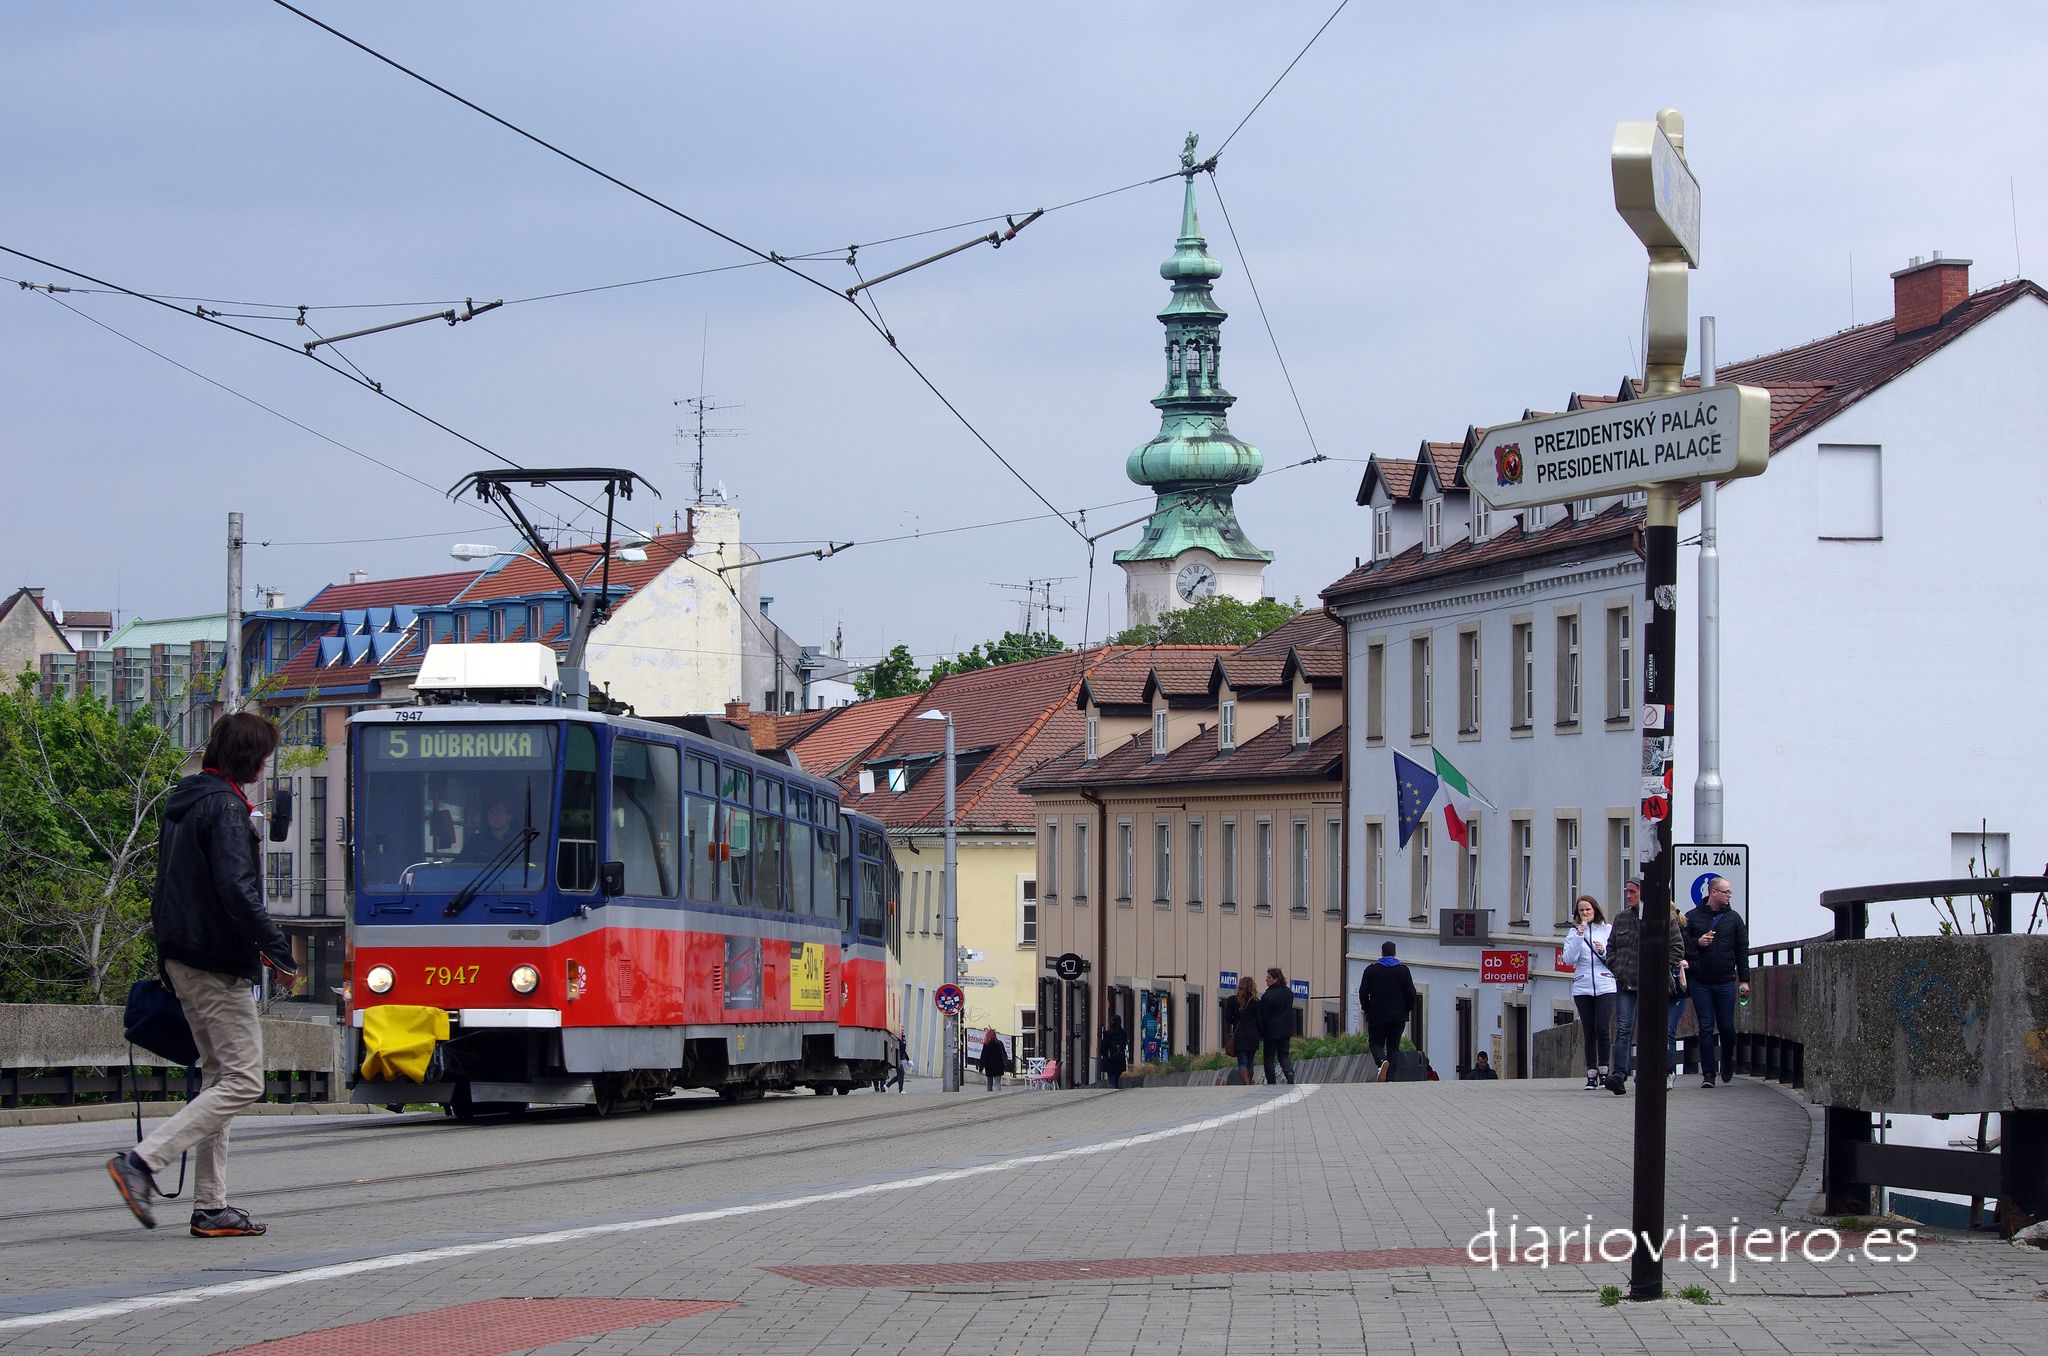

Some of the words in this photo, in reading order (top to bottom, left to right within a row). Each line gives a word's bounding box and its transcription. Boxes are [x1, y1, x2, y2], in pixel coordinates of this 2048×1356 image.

[1534, 411, 1656, 455] PREZIDENTSKÝ
[1661, 402, 1718, 433] PALÁC
[1537, 448, 1650, 483] PRESIDENTIAL
[1655, 433, 1722, 464] PALACE
[395, 711, 424, 721] 7947
[389, 730, 409, 758] 5
[420, 730, 532, 758] DÚBRAVKA
[1680, 850, 1709, 866] PEŠIA
[1713, 850, 1741, 866] ZÓNA
[1484, 956, 1503, 967] ab
[424, 965, 480, 986] 7947
[1484, 971, 1525, 982] drogéria
